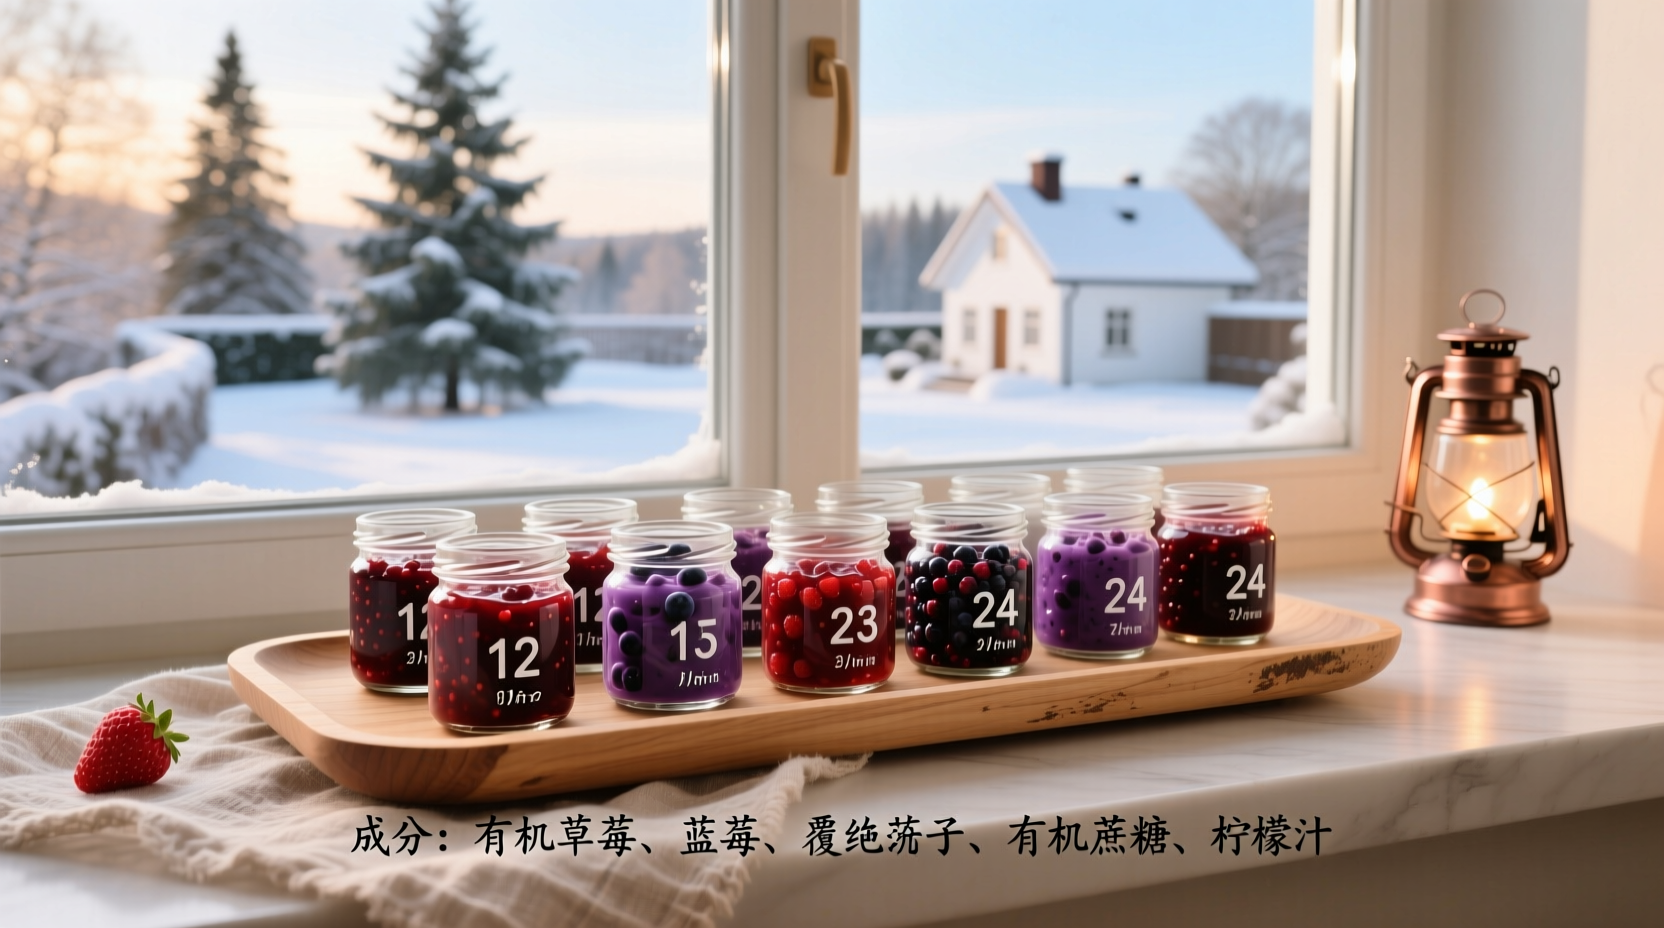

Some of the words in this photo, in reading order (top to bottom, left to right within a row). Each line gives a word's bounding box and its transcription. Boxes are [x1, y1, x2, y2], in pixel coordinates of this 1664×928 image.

[1104, 576, 1147, 613] 24
[1226, 564, 1266, 600] 24
[831, 605, 878, 645] 23
[972, 588, 1019, 629] 24
[489, 637, 540, 679] 12
[671, 619, 718, 661] 15
